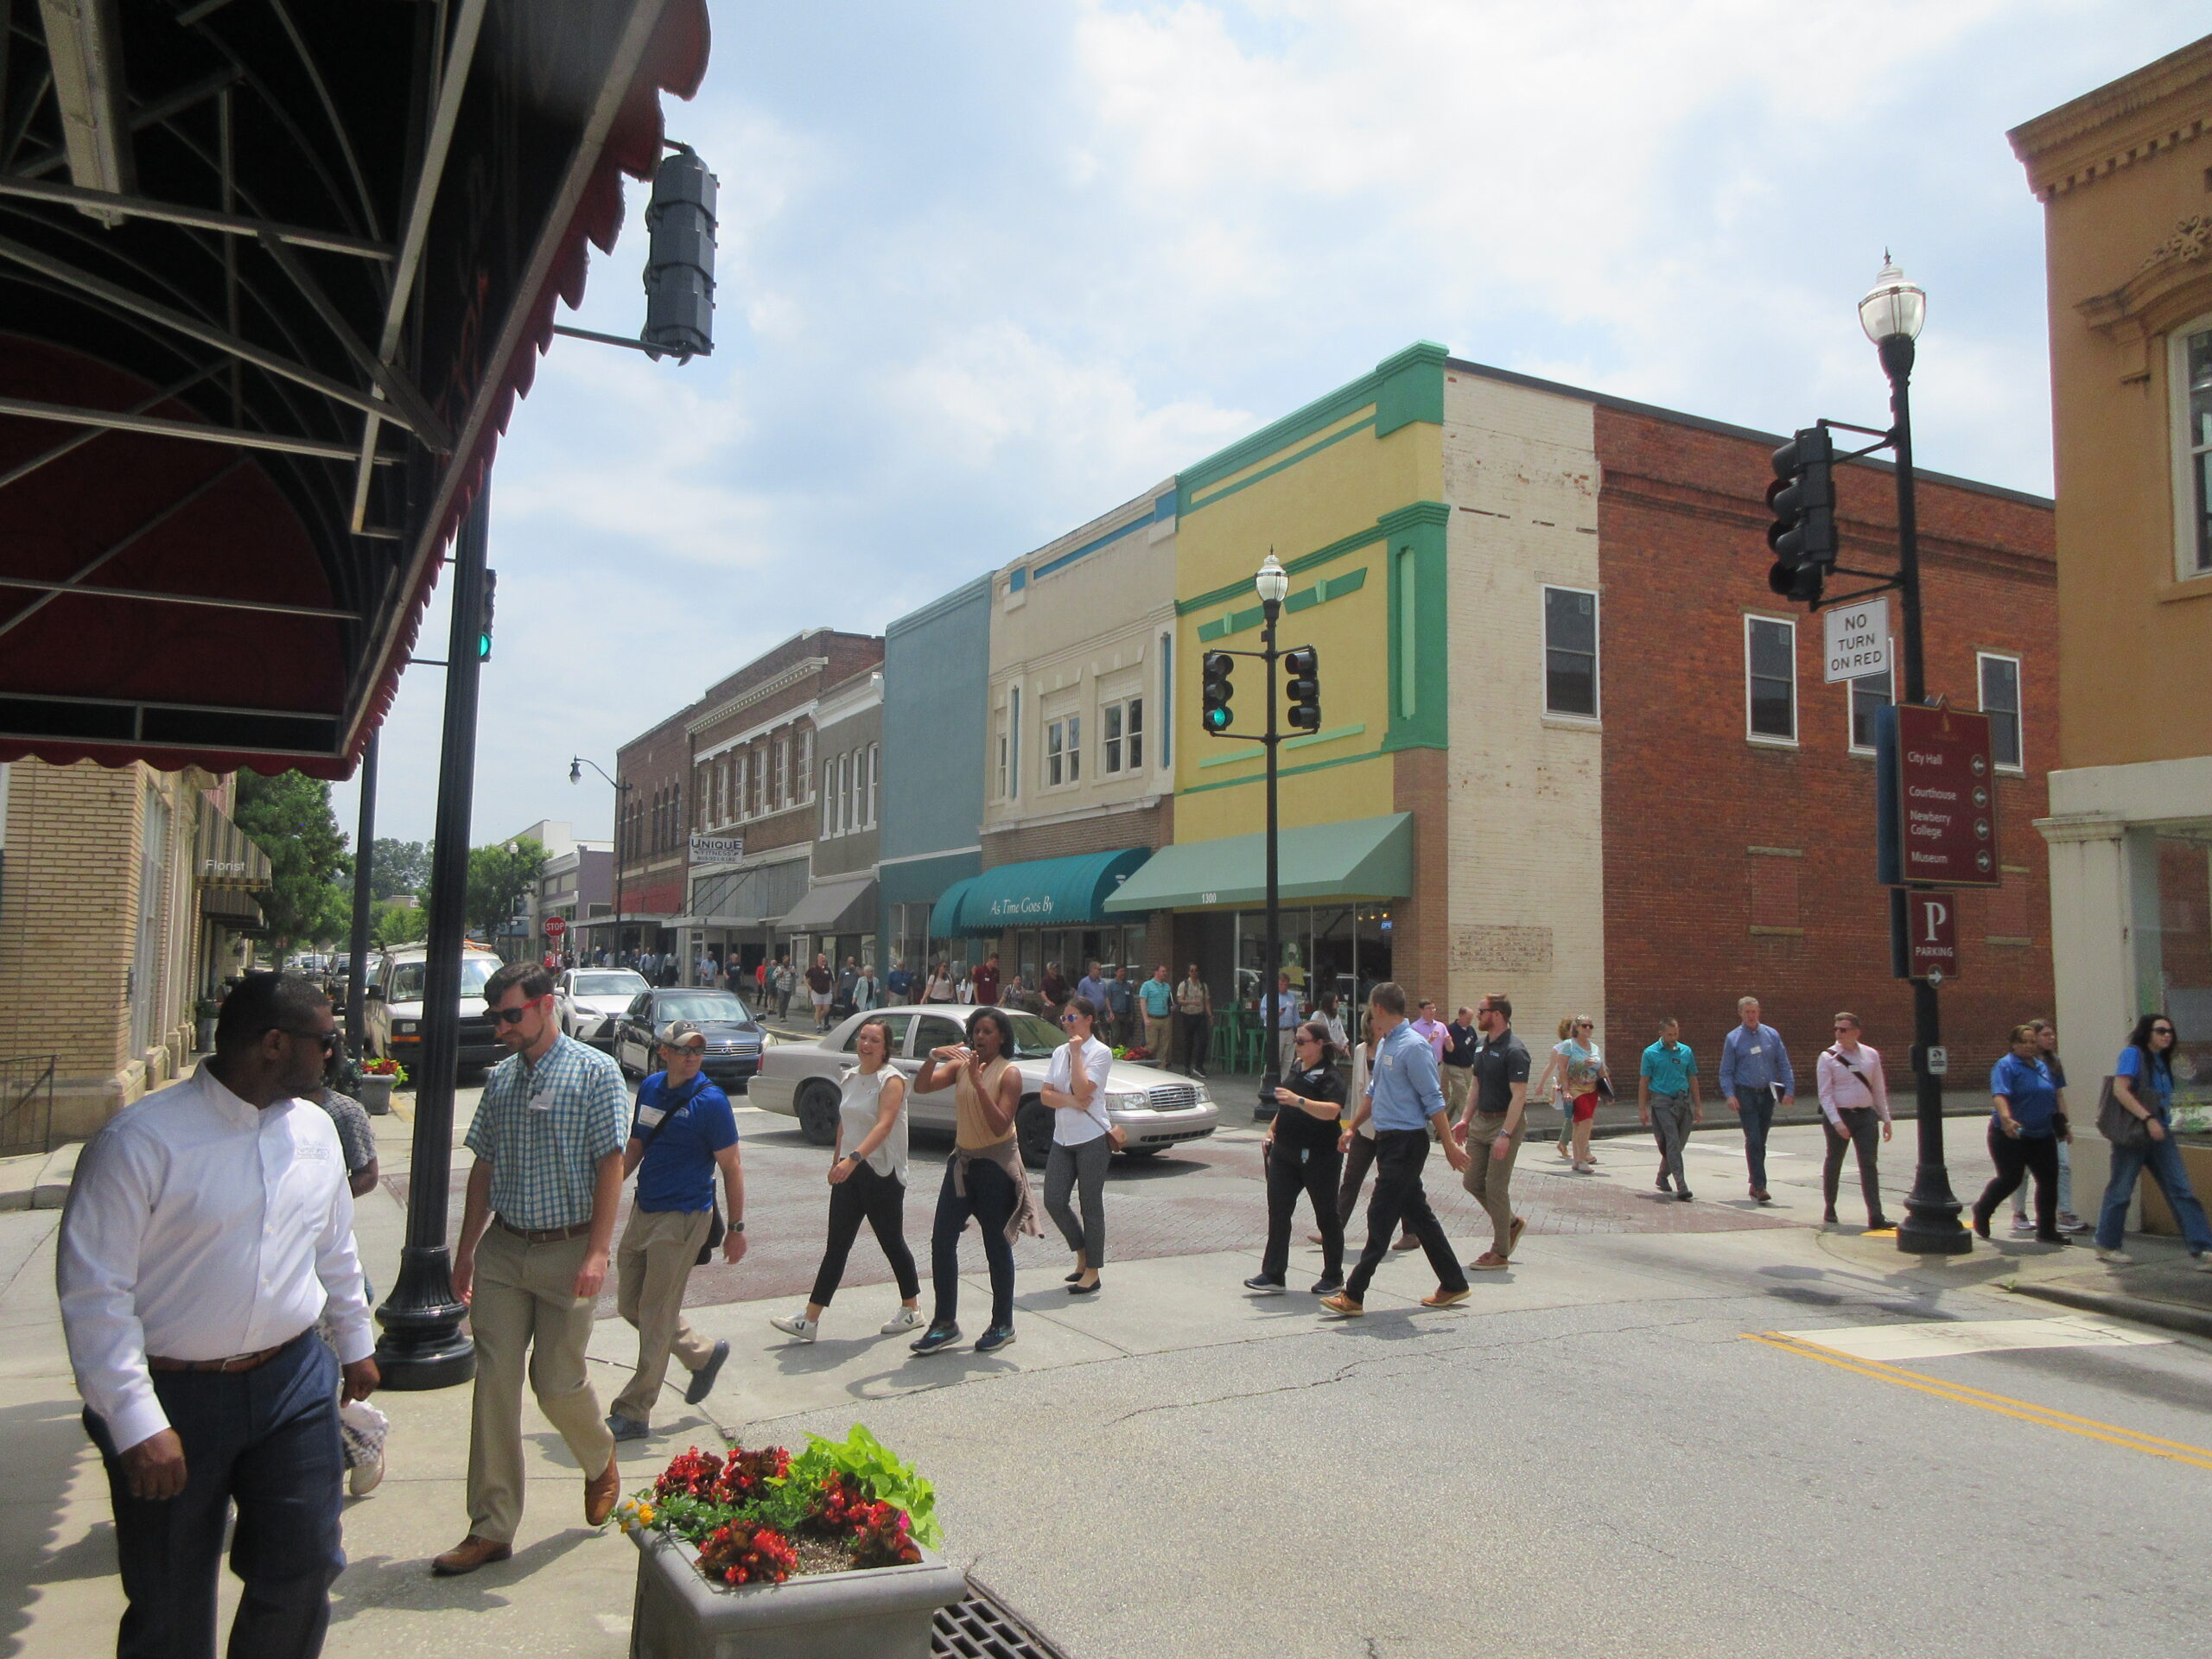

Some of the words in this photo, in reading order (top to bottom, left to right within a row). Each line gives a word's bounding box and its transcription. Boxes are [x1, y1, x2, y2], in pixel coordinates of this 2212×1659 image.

[1845, 613, 1867, 632] NO
[1838, 632, 1875, 652] TURN
[1831, 657, 1850, 671] ON
[1853, 651, 1882, 667] RED
[1907, 751, 1925, 766] City
[1925, 753, 1943, 766] Hall
[1909, 785, 1957, 800] Courthouse
[1910, 810, 1952, 827] Newberry
[1910, 823, 1942, 840] College
[691, 838, 742, 850] UNIQUE
[1911, 851, 1948, 864] Museum
[206, 859, 246, 872] Florist
[990, 899, 1001, 915] As
[1003, 899, 1020, 914] Time
[1020, 897, 1041, 912] Goes
[1042, 895, 1054, 914] By
[1202, 892, 1217, 904] 1300
[545, 922, 566, 931] STOP
[1923, 901, 1947, 941] P
[1915, 946, 1954, 957] PARKING
